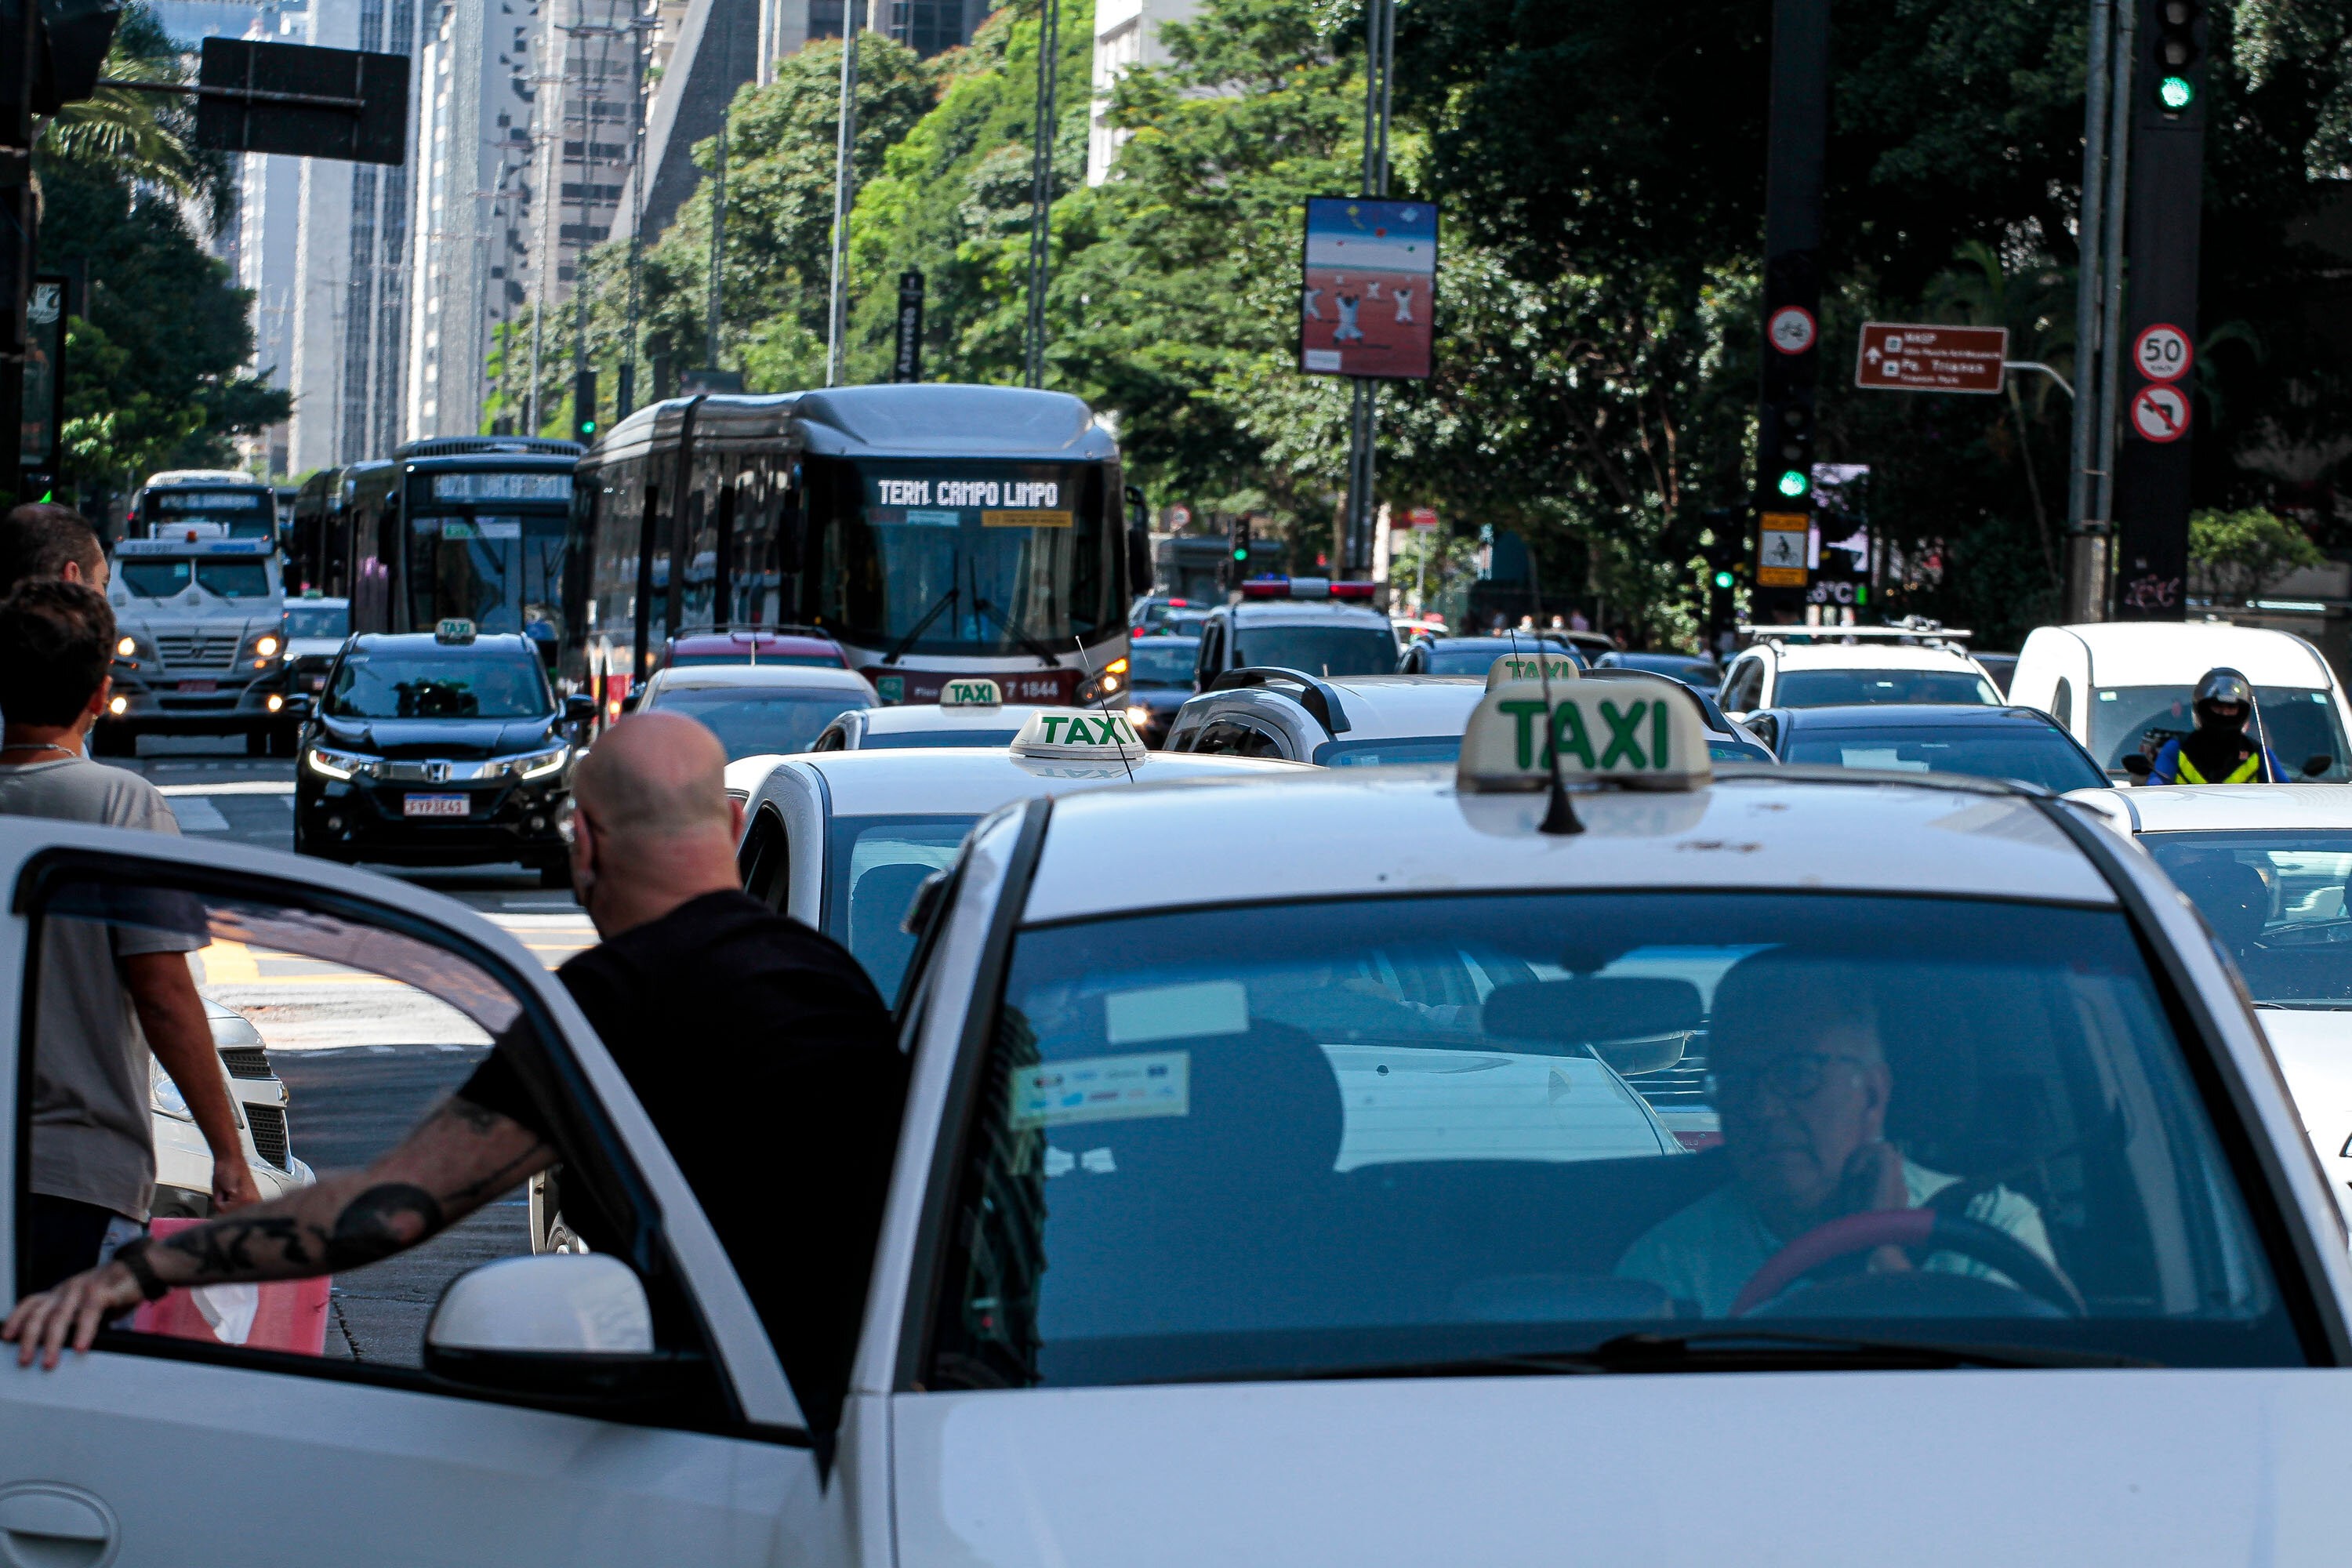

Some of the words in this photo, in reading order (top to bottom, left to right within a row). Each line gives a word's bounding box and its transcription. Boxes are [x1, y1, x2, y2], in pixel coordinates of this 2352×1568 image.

[2144, 338, 2181, 362] 50
[877, 480, 932, 506] TERM.
[937, 481, 1000, 506] CAMPO
[1004, 481, 1058, 507] LIMPO
[442, 622, 470, 633] TAXI
[1504, 661, 1569, 681] TAXI
[950, 684, 993, 702] TAXI
[1005, 681, 1018, 698] 7
[1022, 681, 1058, 697] 1844
[1041, 717, 1137, 746] TAXI
[1497, 699, 1668, 770] TAXI
